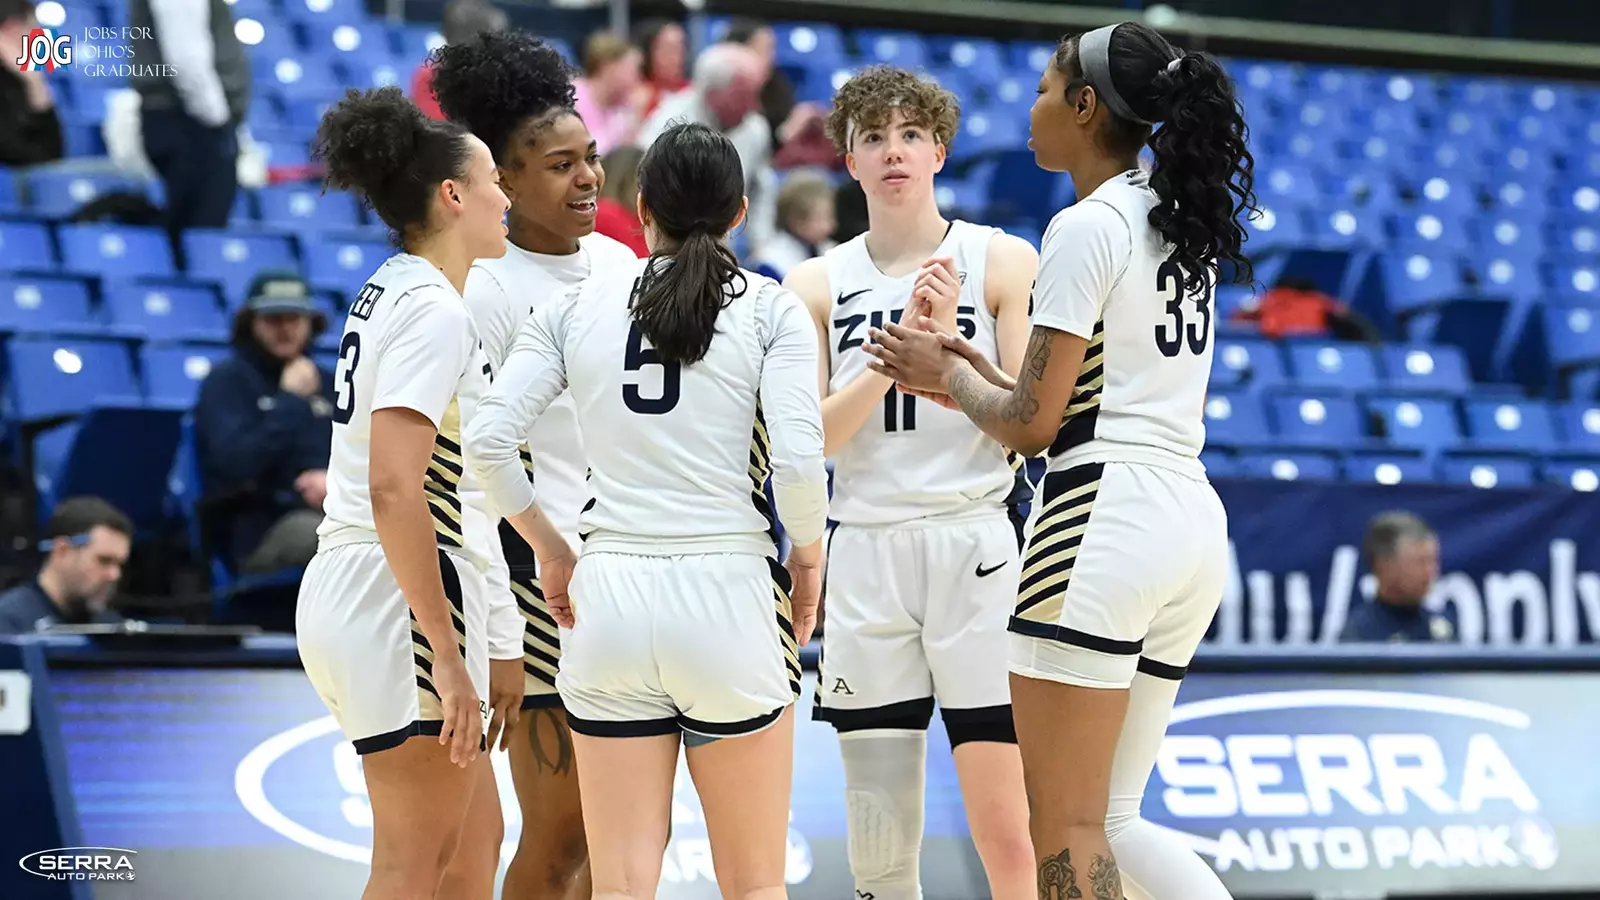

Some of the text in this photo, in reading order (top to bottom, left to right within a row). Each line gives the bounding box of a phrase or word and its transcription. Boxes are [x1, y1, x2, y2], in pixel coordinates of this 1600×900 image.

[834, 306, 976, 354] ZIS
[1155, 258, 1210, 357] 33
[622, 320, 681, 414] 5
[832, 677, 854, 695] A
[1156, 733, 1540, 818] SERRA
[1215, 825, 1522, 871] AUTO PARK
